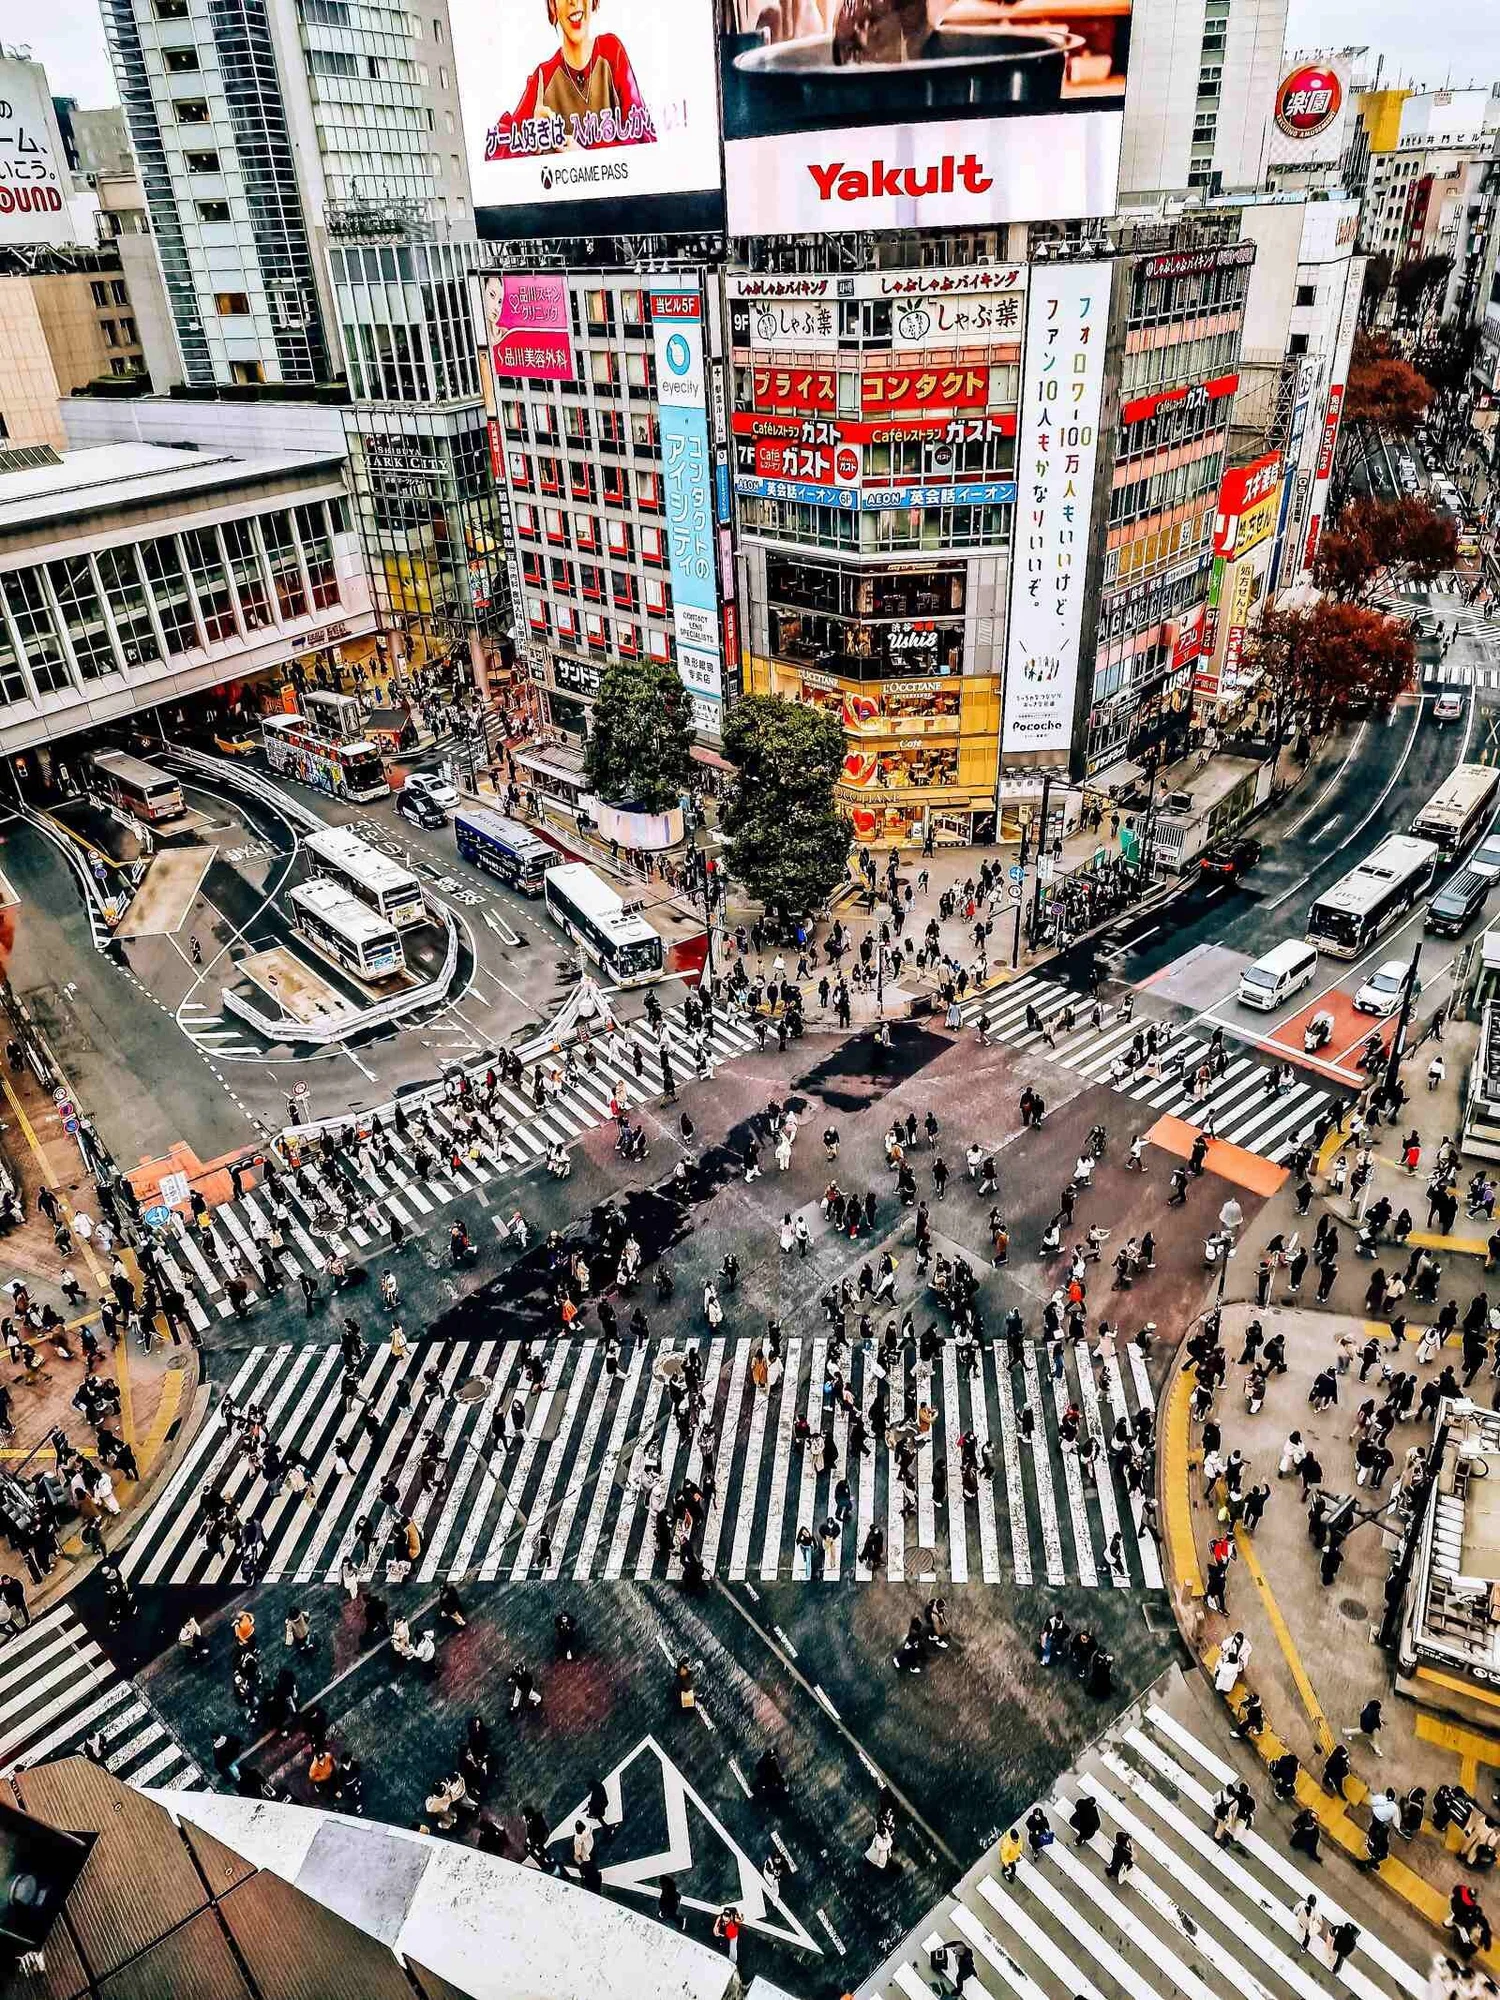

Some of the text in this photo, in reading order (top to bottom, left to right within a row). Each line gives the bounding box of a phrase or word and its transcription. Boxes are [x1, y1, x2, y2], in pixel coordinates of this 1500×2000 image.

[485, 116, 565, 156] ゲーム好きは
[555, 163, 628, 184] PC GAME PASS
[808, 154, 993, 201] Yakult
[737, 279, 829, 297] しゃぶしゃぶバイキング
[881, 270, 1020, 295] しゃぶしゃぶバイキング
[522, 304, 559, 321] クリニック
[734, 314, 749, 331] 9F
[780, 308, 833, 336] しゃぶ葉
[937, 298, 1020, 331] しゃぶ葉
[504, 346, 568, 371] 品川美容外科
[662, 380, 700, 398] eyecity
[755, 373, 835, 399] プライス
[862, 371, 985, 401] コンタクト
[802, 422, 842, 446] ガスト
[945, 420, 1002, 445] ガスト
[1319, 421, 1336, 470] TaxFree
[360, 455, 449, 470] MARK CITY
[783, 448, 831, 480] ガスト
[766, 480, 836, 503] 英会話イーオン
[866, 492, 901, 506] AEON
[909, 482, 1014, 506] 英会話イーオン
[665, 433, 692, 577] アイシティ
[687, 435, 710, 580] コンタクトの
[883, 682, 943, 693] L'OCCITANE
[1162, 666, 1191, 697] LUSH
